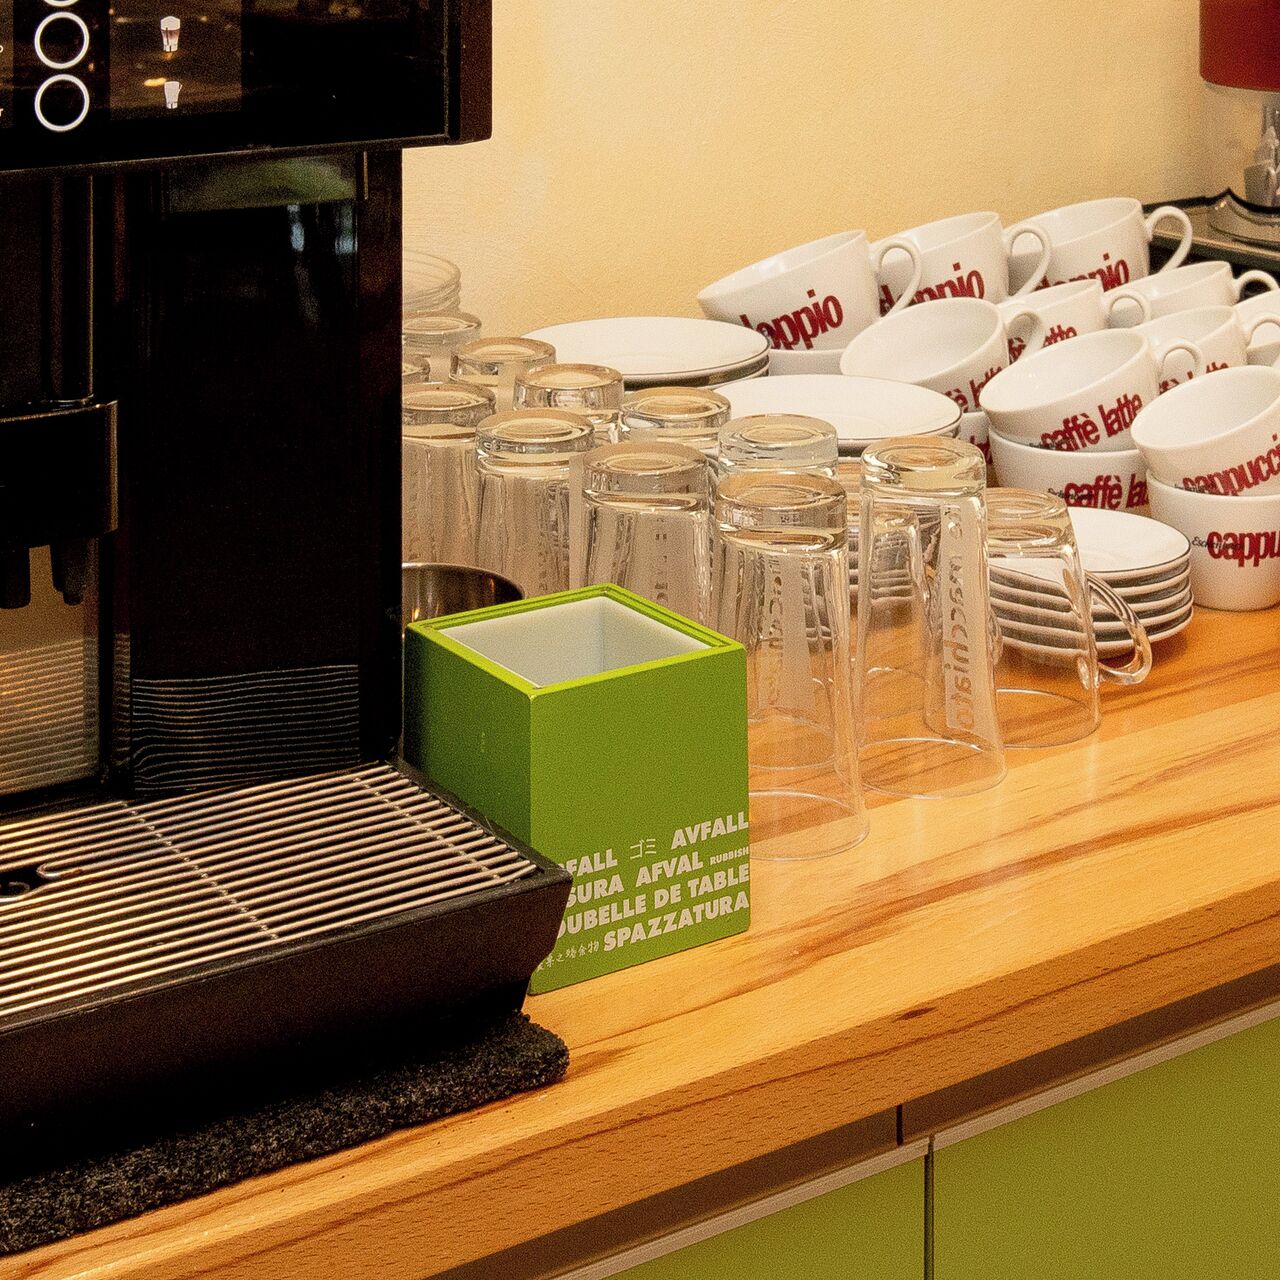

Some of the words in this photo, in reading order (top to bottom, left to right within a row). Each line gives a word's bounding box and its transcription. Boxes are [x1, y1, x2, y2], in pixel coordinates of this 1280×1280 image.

[1064, 474, 1123, 511] caffè
[671, 811, 749, 850] AVFALL
[558, 848, 619, 878] FALL
[635, 851, 704, 888] AFVAL
[709, 846, 749, 867] RUBBISH
[654, 883, 682, 910] DE
[687, 862, 750, 899] TABLE
[603, 890, 750, 952] SPAZZATURA
